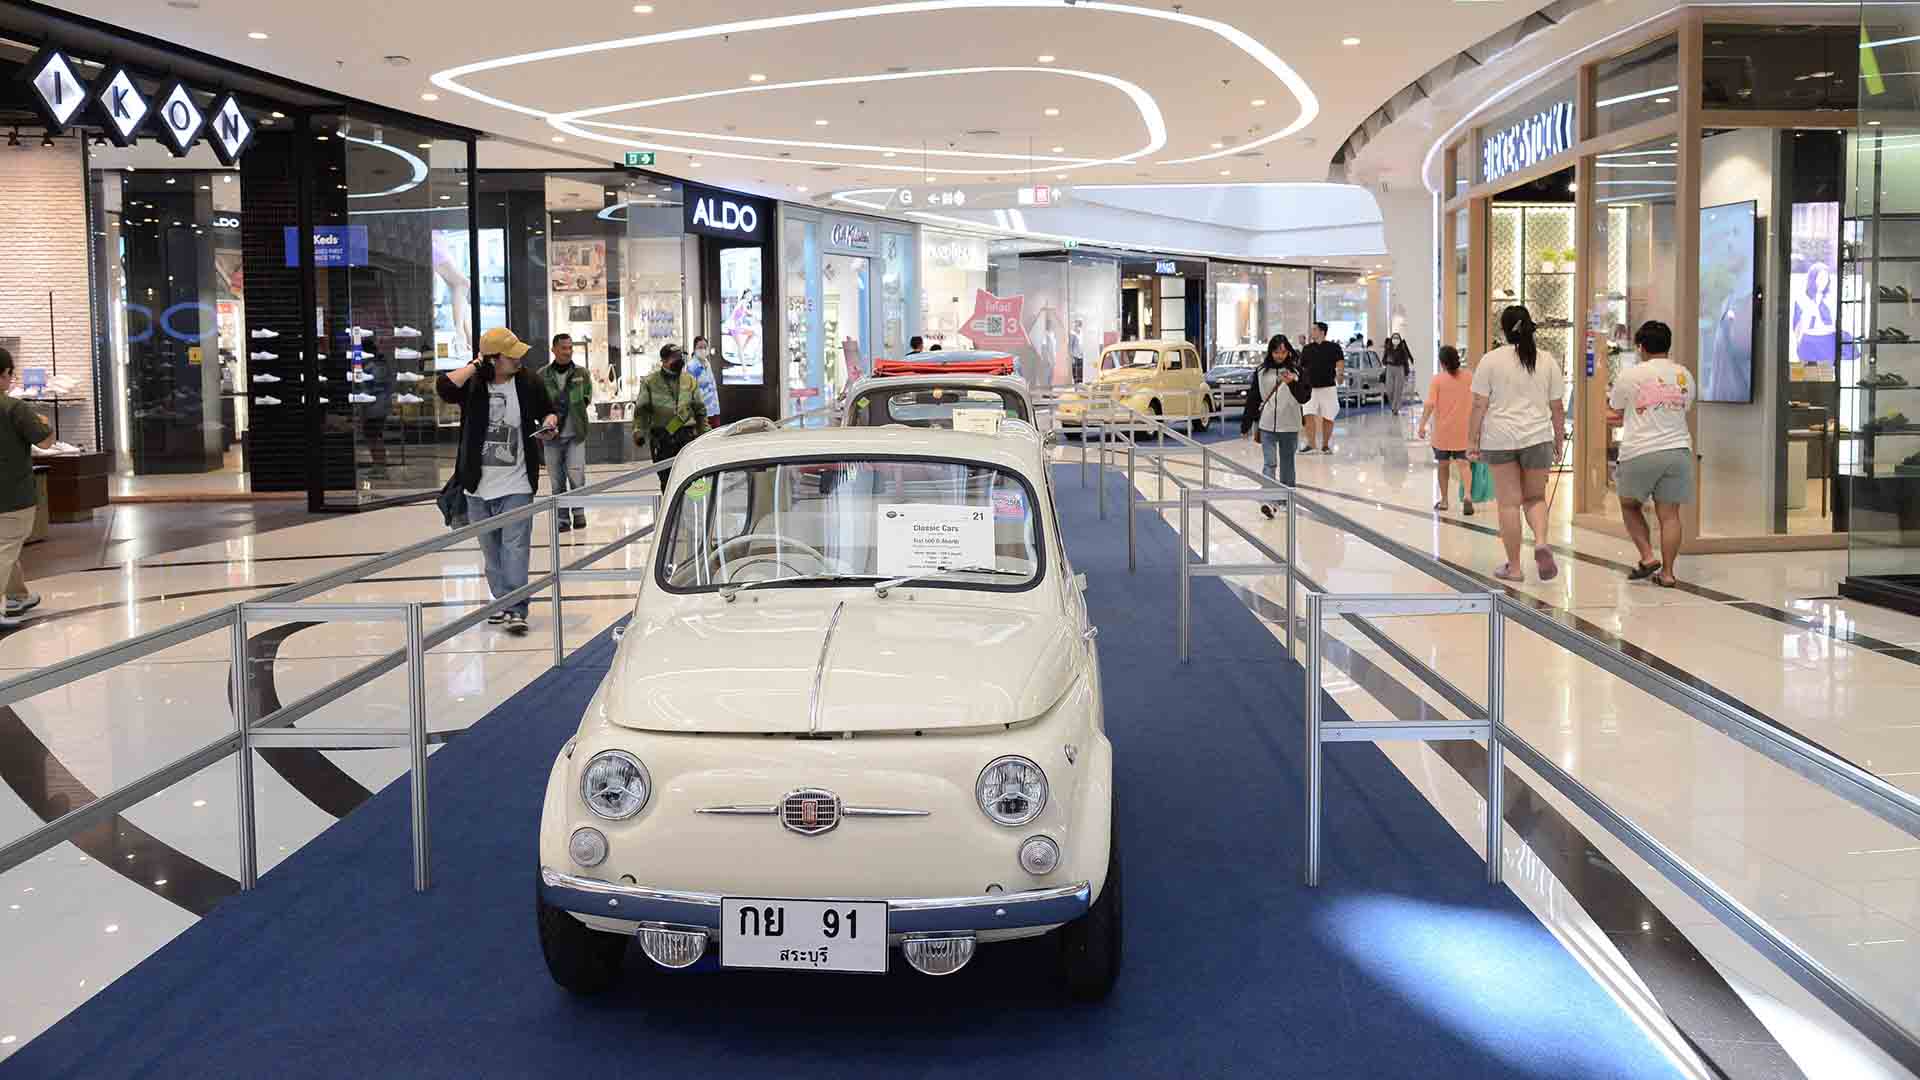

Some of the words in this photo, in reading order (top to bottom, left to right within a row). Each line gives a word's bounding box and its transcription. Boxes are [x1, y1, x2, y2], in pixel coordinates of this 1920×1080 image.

[53, 70, 239, 144] IKON
[692, 197, 757, 233] ALDO
[313, 233, 339, 245] Keds
[972, 512, 984, 521] 21
[913, 524, 940, 532] Classic
[942, 524, 959, 532] Cars
[739, 905, 785, 937] กย
[822, 908, 857, 939] 91
[779, 946, 829, 967] สระบุรี
